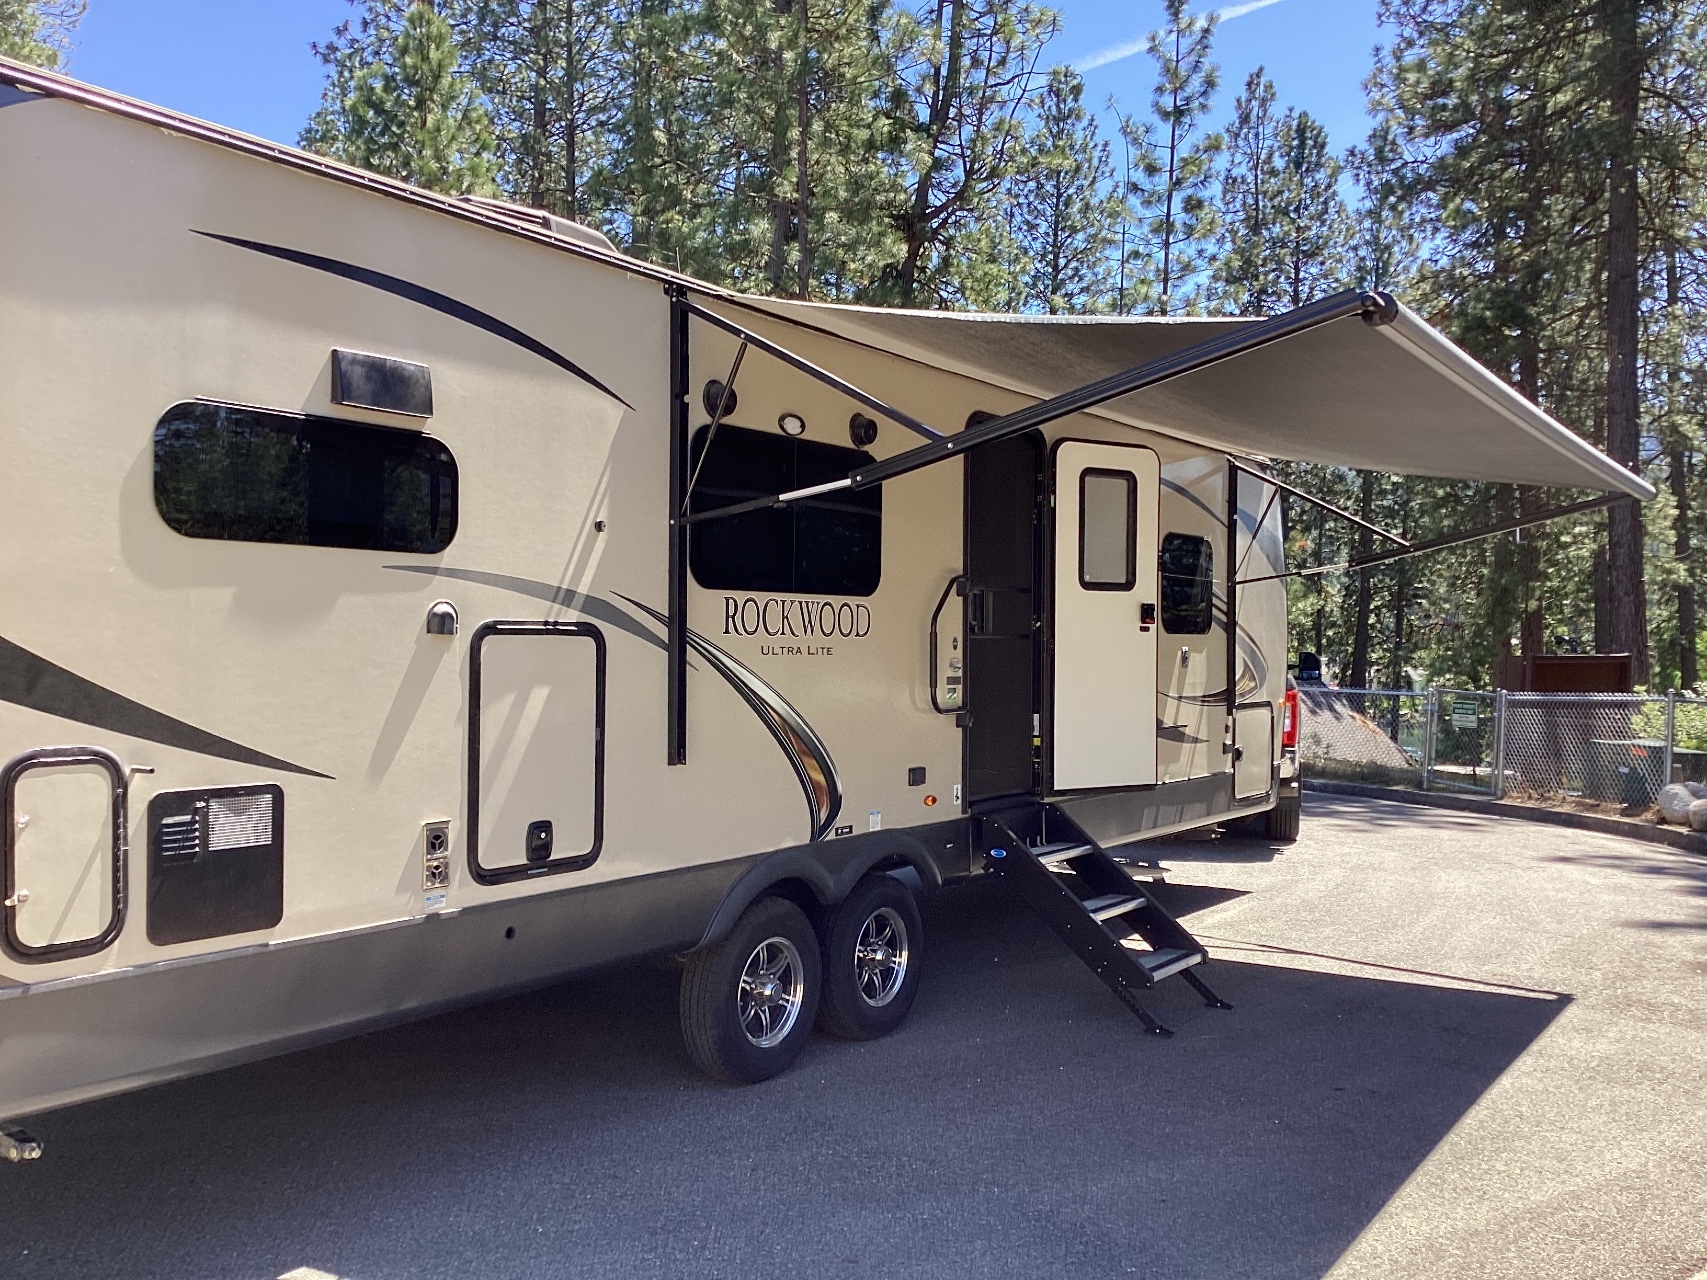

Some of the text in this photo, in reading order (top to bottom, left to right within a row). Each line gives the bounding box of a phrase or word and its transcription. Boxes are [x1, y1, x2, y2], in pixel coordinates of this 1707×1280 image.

[722, 596, 871, 638] ROCKWOOD
[761, 645, 834, 656] ULTRA LITE
